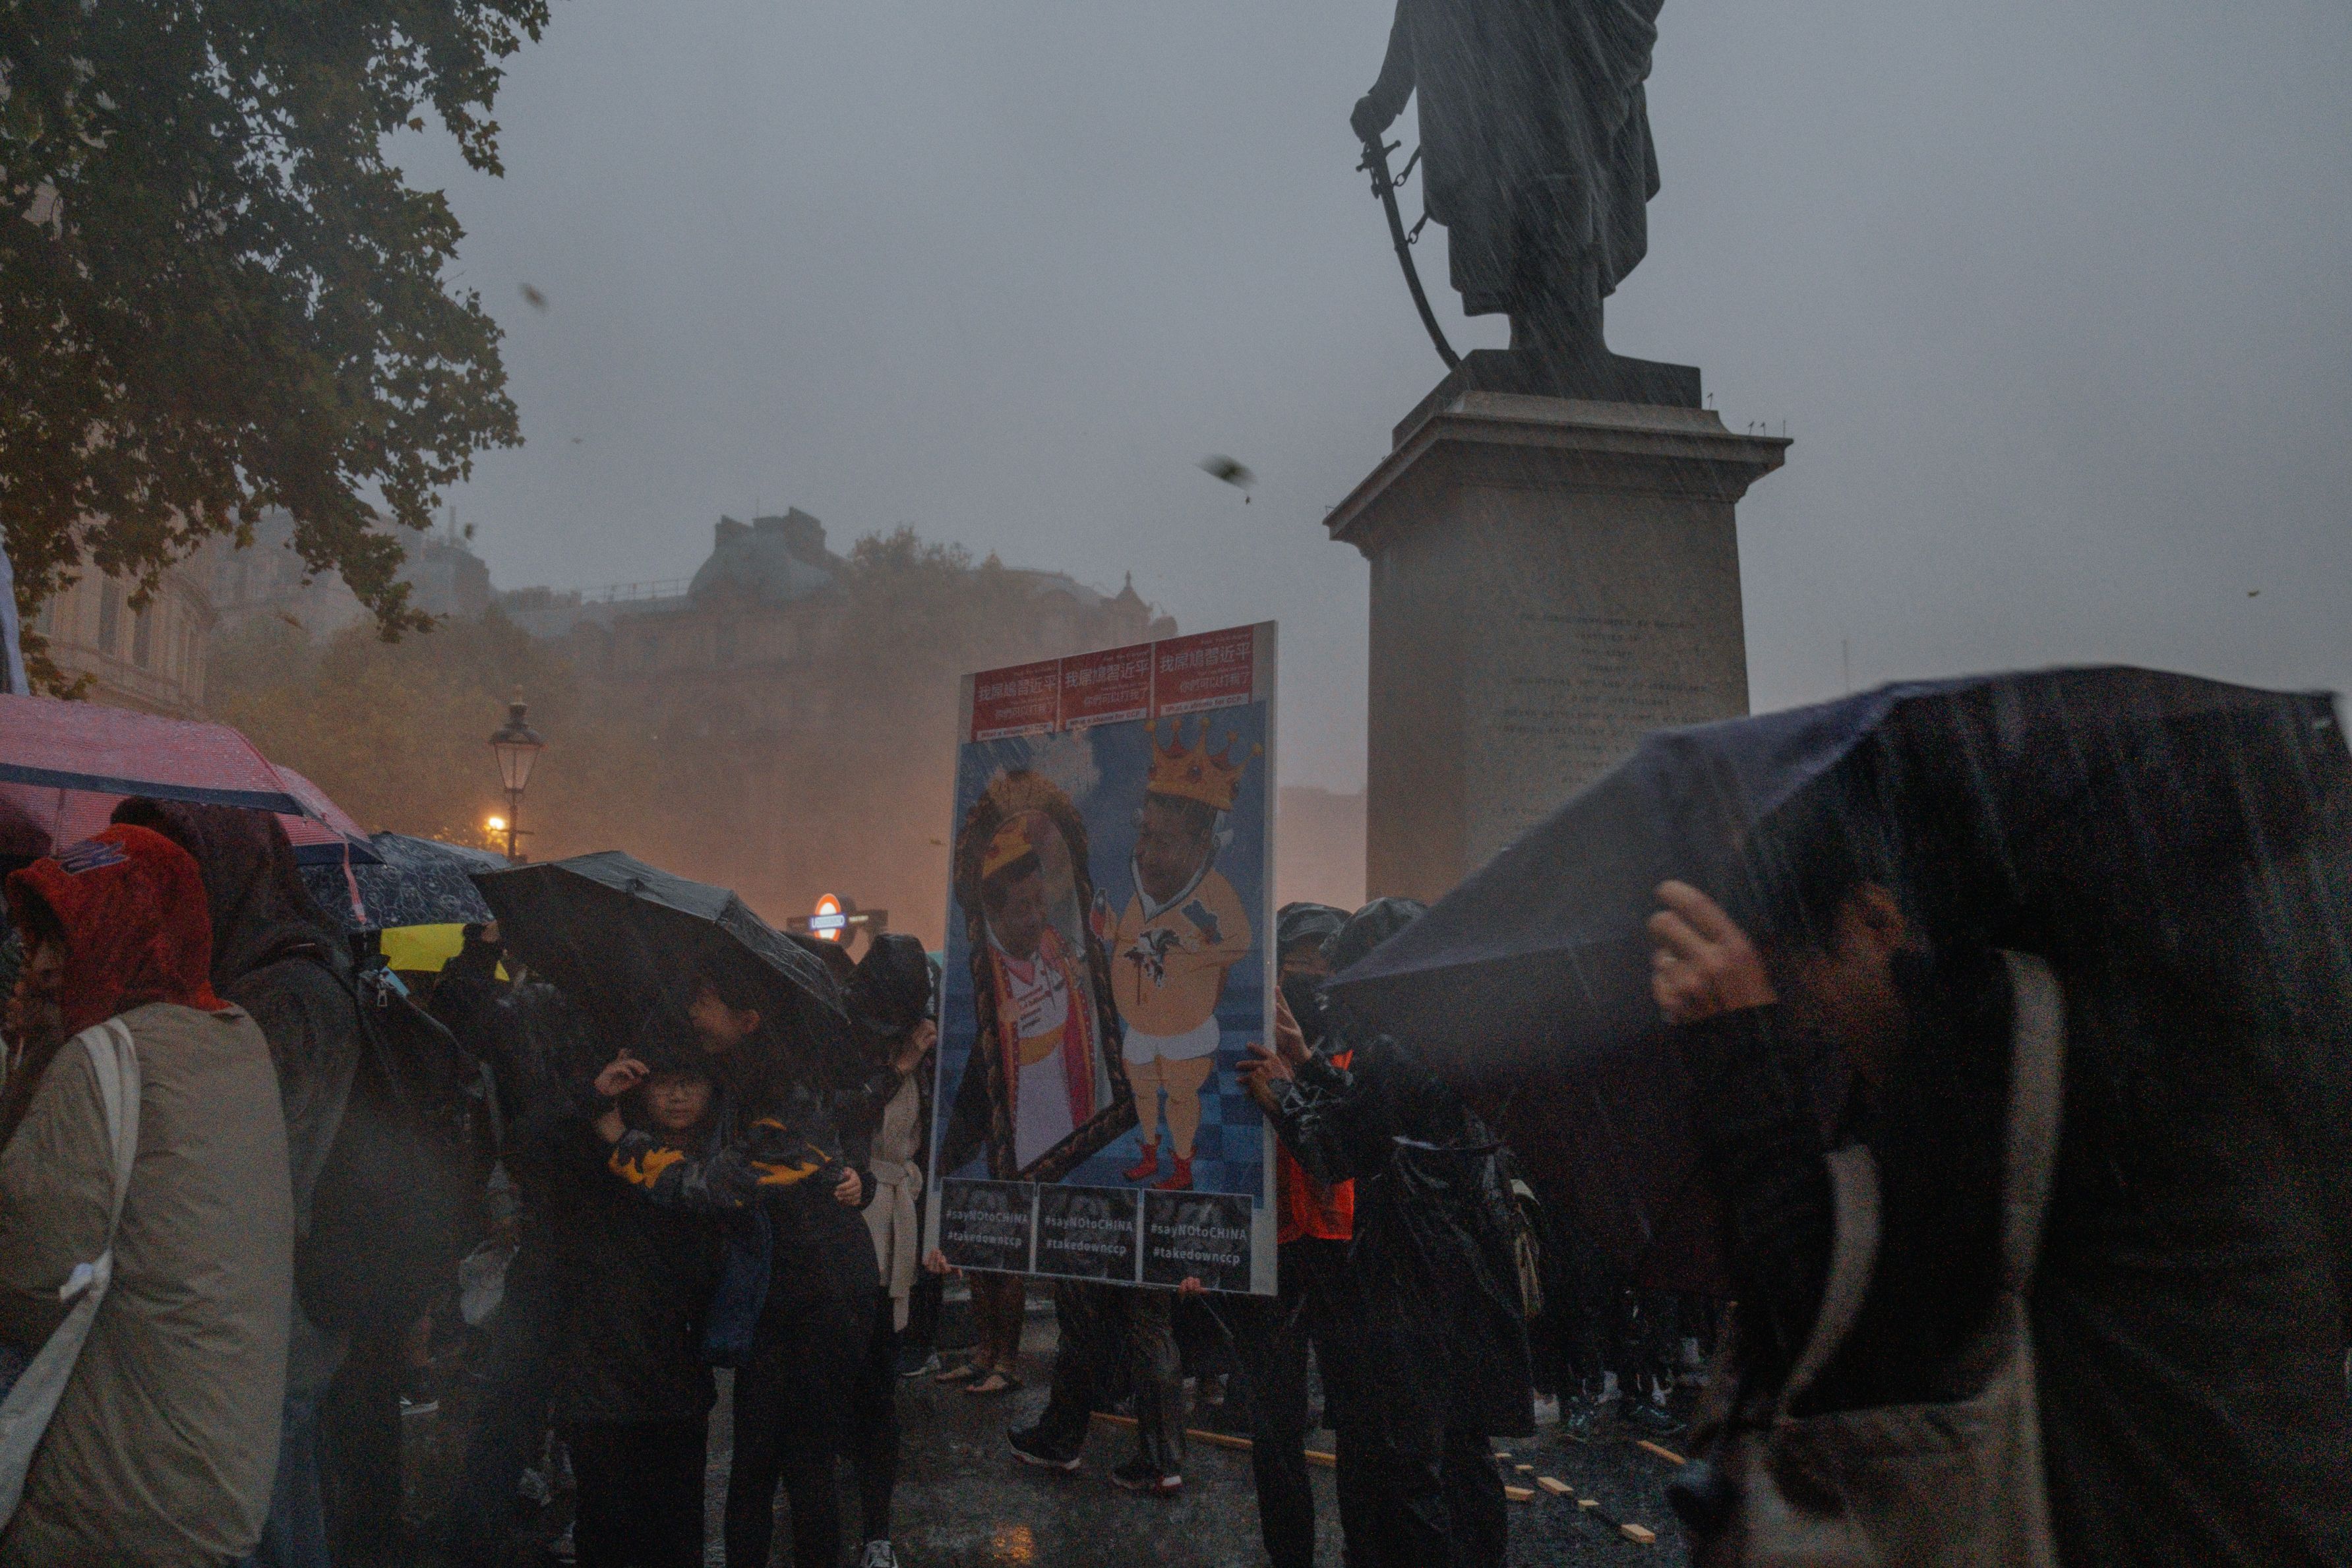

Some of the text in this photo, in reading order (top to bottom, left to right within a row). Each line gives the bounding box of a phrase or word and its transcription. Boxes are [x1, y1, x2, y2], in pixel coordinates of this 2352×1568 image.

[1226, 696, 1242, 704] CCP
[1151, 1223, 1247, 1241] #sayNOtoCHINA
[1046, 1237, 1126, 1256] #takedownccp
[1153, 1246, 1240, 1267] #takedownccp
